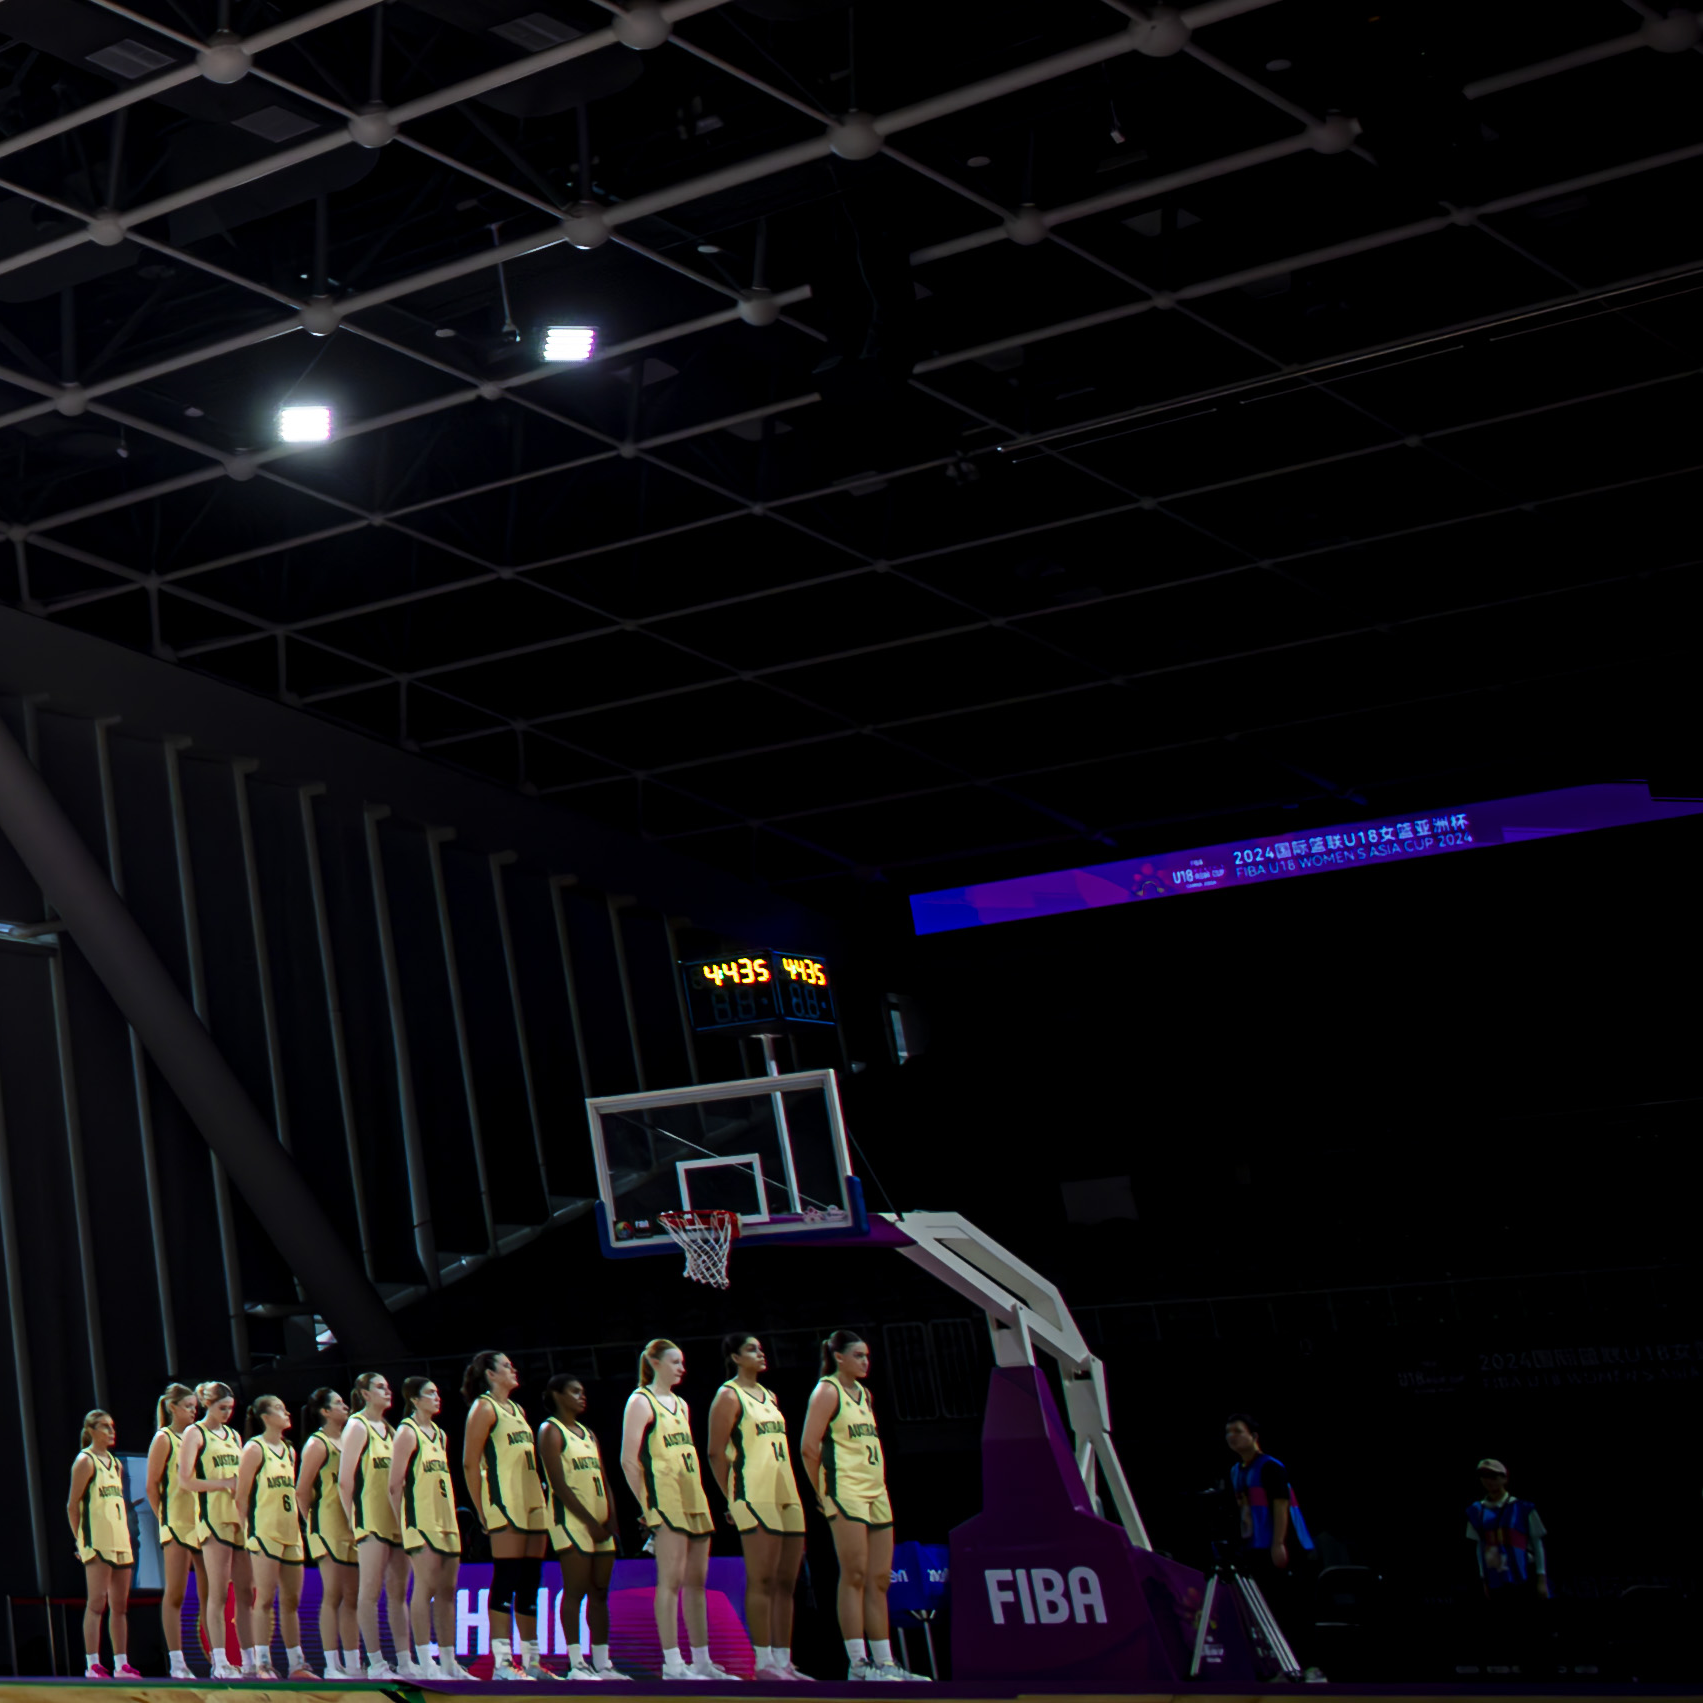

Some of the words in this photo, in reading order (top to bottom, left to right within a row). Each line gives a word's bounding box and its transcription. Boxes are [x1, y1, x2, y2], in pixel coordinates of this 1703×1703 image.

[1236, 864, 1266, 879] FIBA
[1369, 842, 1401, 858] ASIA
[1404, 837, 1434, 852] CUP
[1436, 831, 1473, 848] 2024
[771, 1441, 786, 1462] 14
[681, 1452, 695, 1473] 12
[439, 1478, 448, 1498] 9
[282, 1494, 292, 1512] 6
[984, 1565, 1108, 1625] FIBA
